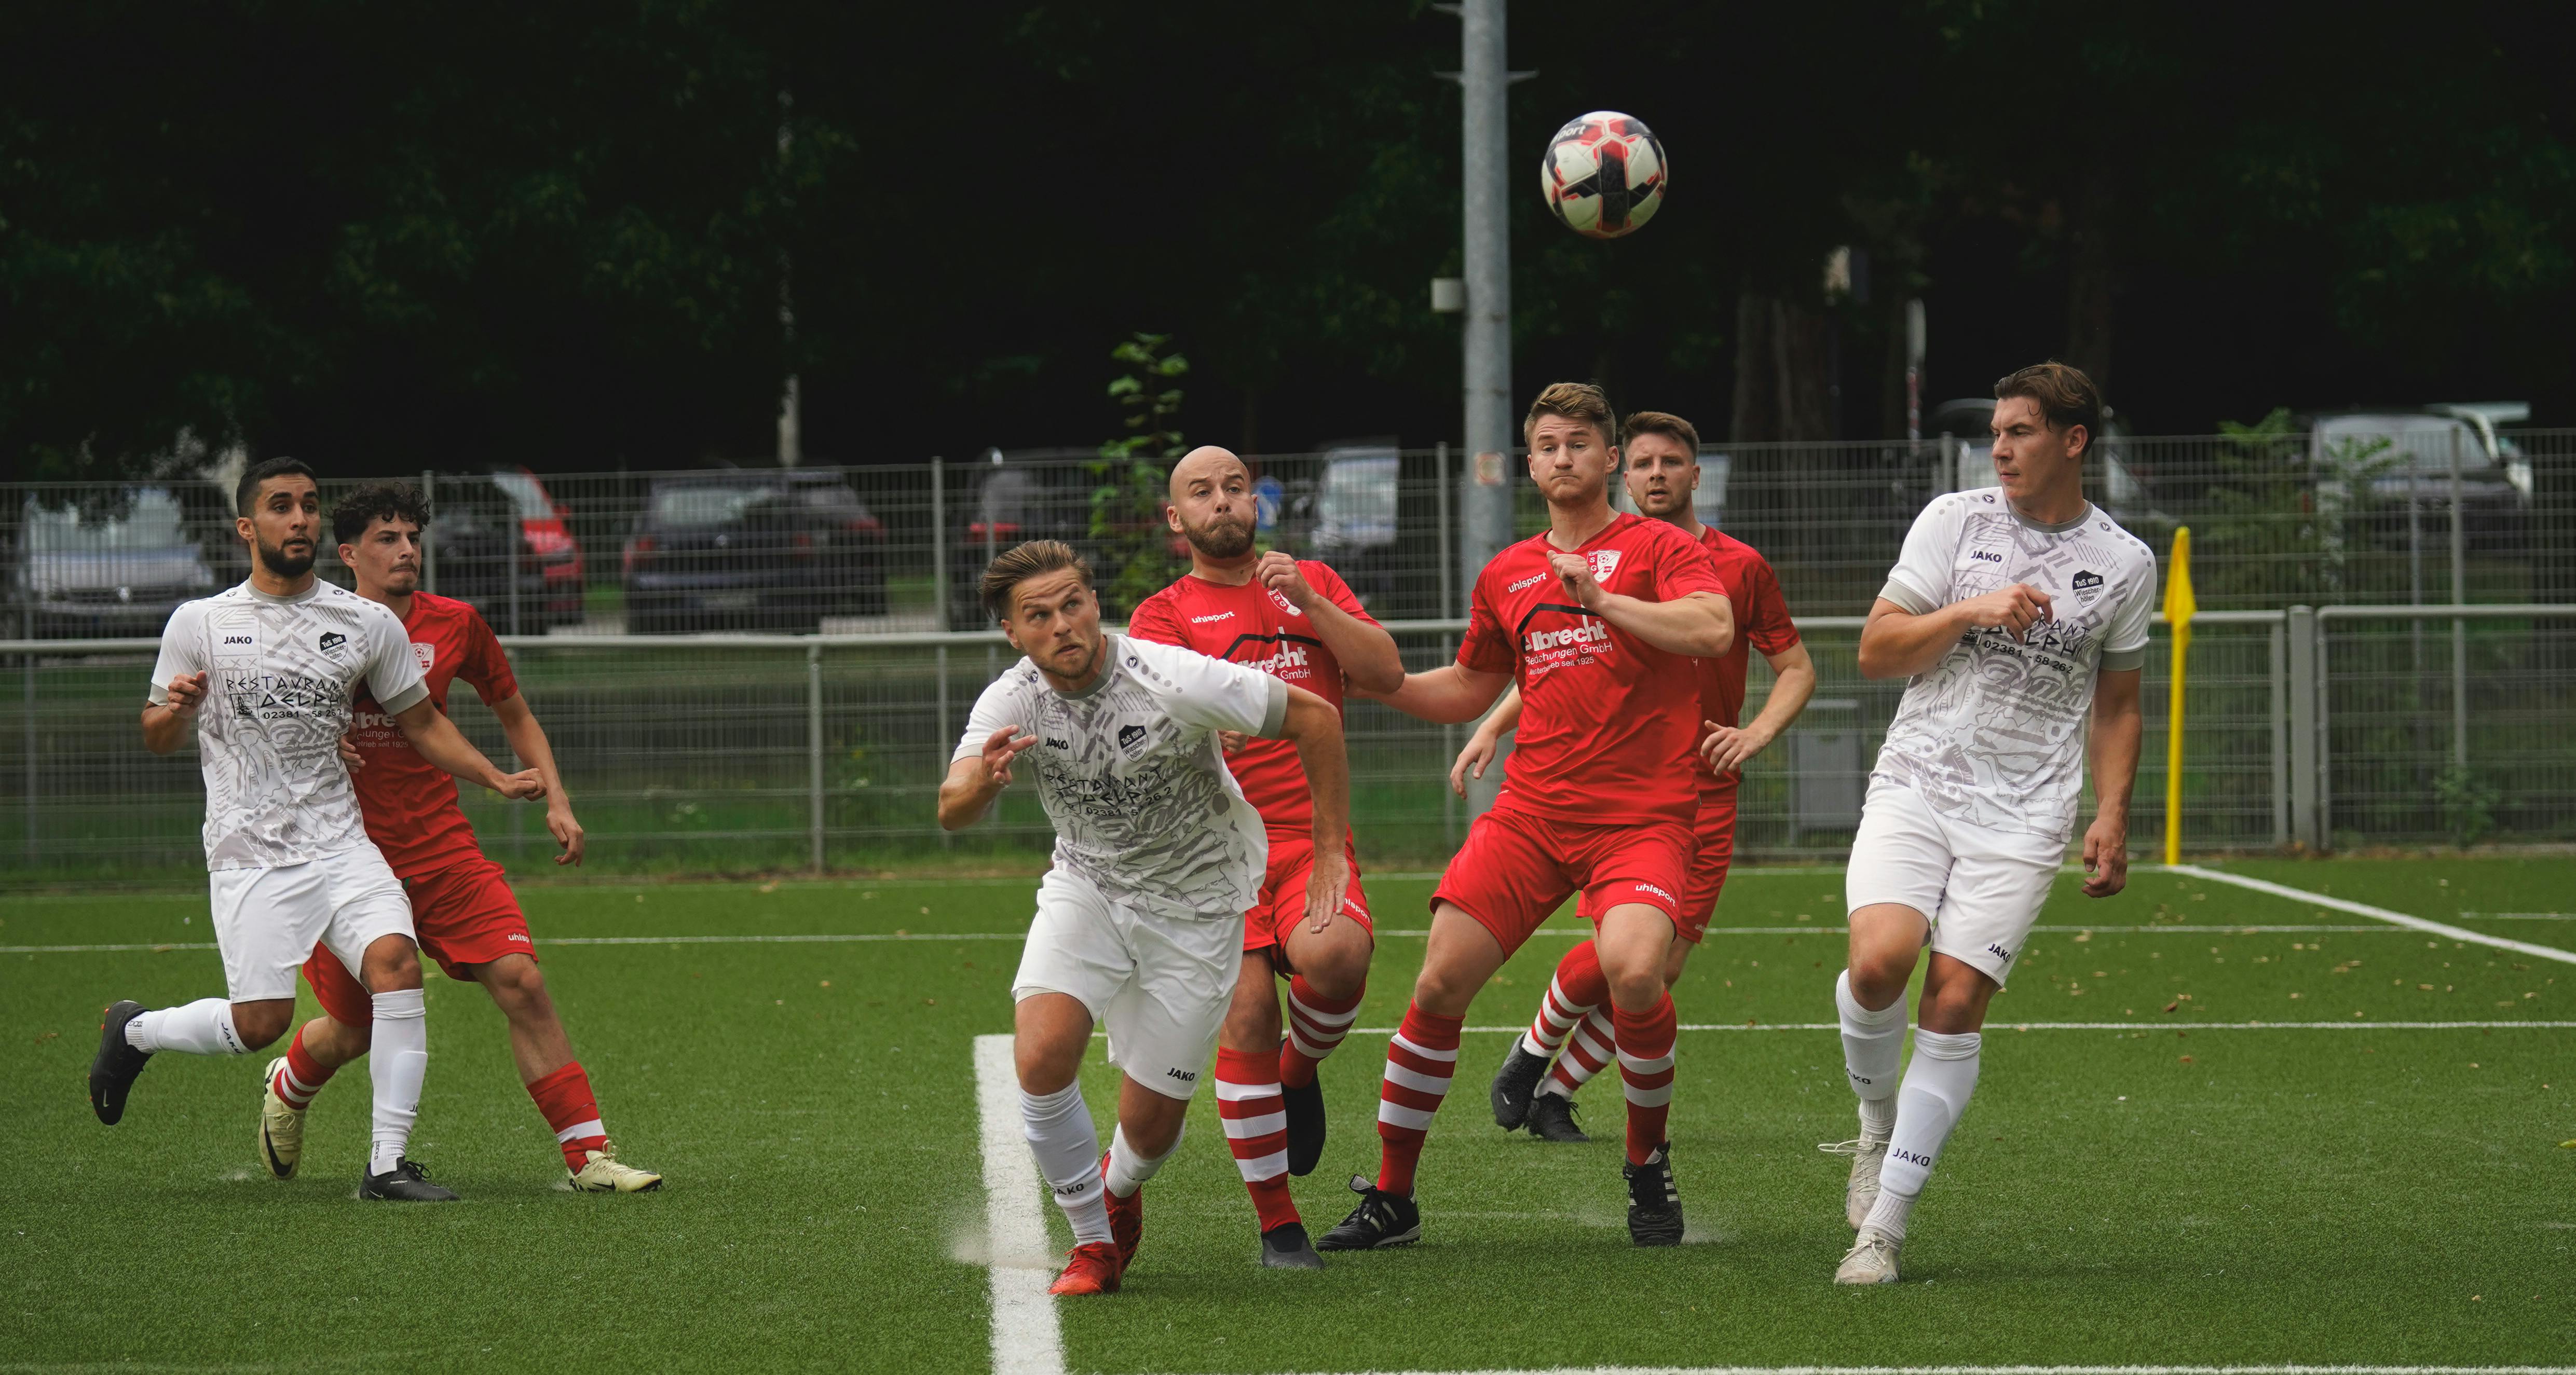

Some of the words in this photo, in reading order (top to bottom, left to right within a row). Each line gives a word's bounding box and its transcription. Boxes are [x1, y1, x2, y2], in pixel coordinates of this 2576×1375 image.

[1557, 125, 1586, 141] port
[1971, 551, 2002, 562] JAKO
[1508, 572, 1547, 593] uhlsport
[2075, 579, 2087, 587] TuS
[2087, 576, 2100, 585] 1910
[1191, 611, 1235, 623] uhlsport
[224, 636, 252, 644] JAKO
[322, 640, 333, 648] TuS
[332, 636, 343, 644] 1910
[1579, 642, 1613, 654] GmbH
[1576, 656, 1594, 665] 1925
[1984, 640, 2023, 657] 02381
[2035, 655, 2049, 665] 58
[2052, 661, 2074, 674] 262
[1280, 668, 1312, 680] GmbH
[263, 711, 299, 720] 02381
[312, 710, 322, 718] 58
[1121, 735, 1132, 745] TuS
[1132, 728, 1143, 739] 1910
[1045, 737, 1069, 750] JAKO
[1086, 807, 1121, 816] 02381
[1146, 787, 1172, 806] 262
[1635, 883, 1675, 906] uhlsport
[508, 933, 529, 943] uhlsp
[1988, 943, 2011, 963] JAKO
[1166, 1067, 1195, 1081] JAKO
[1847, 1068, 1871, 1084] AKO
[1893, 1148, 1930, 1166] JAKO
